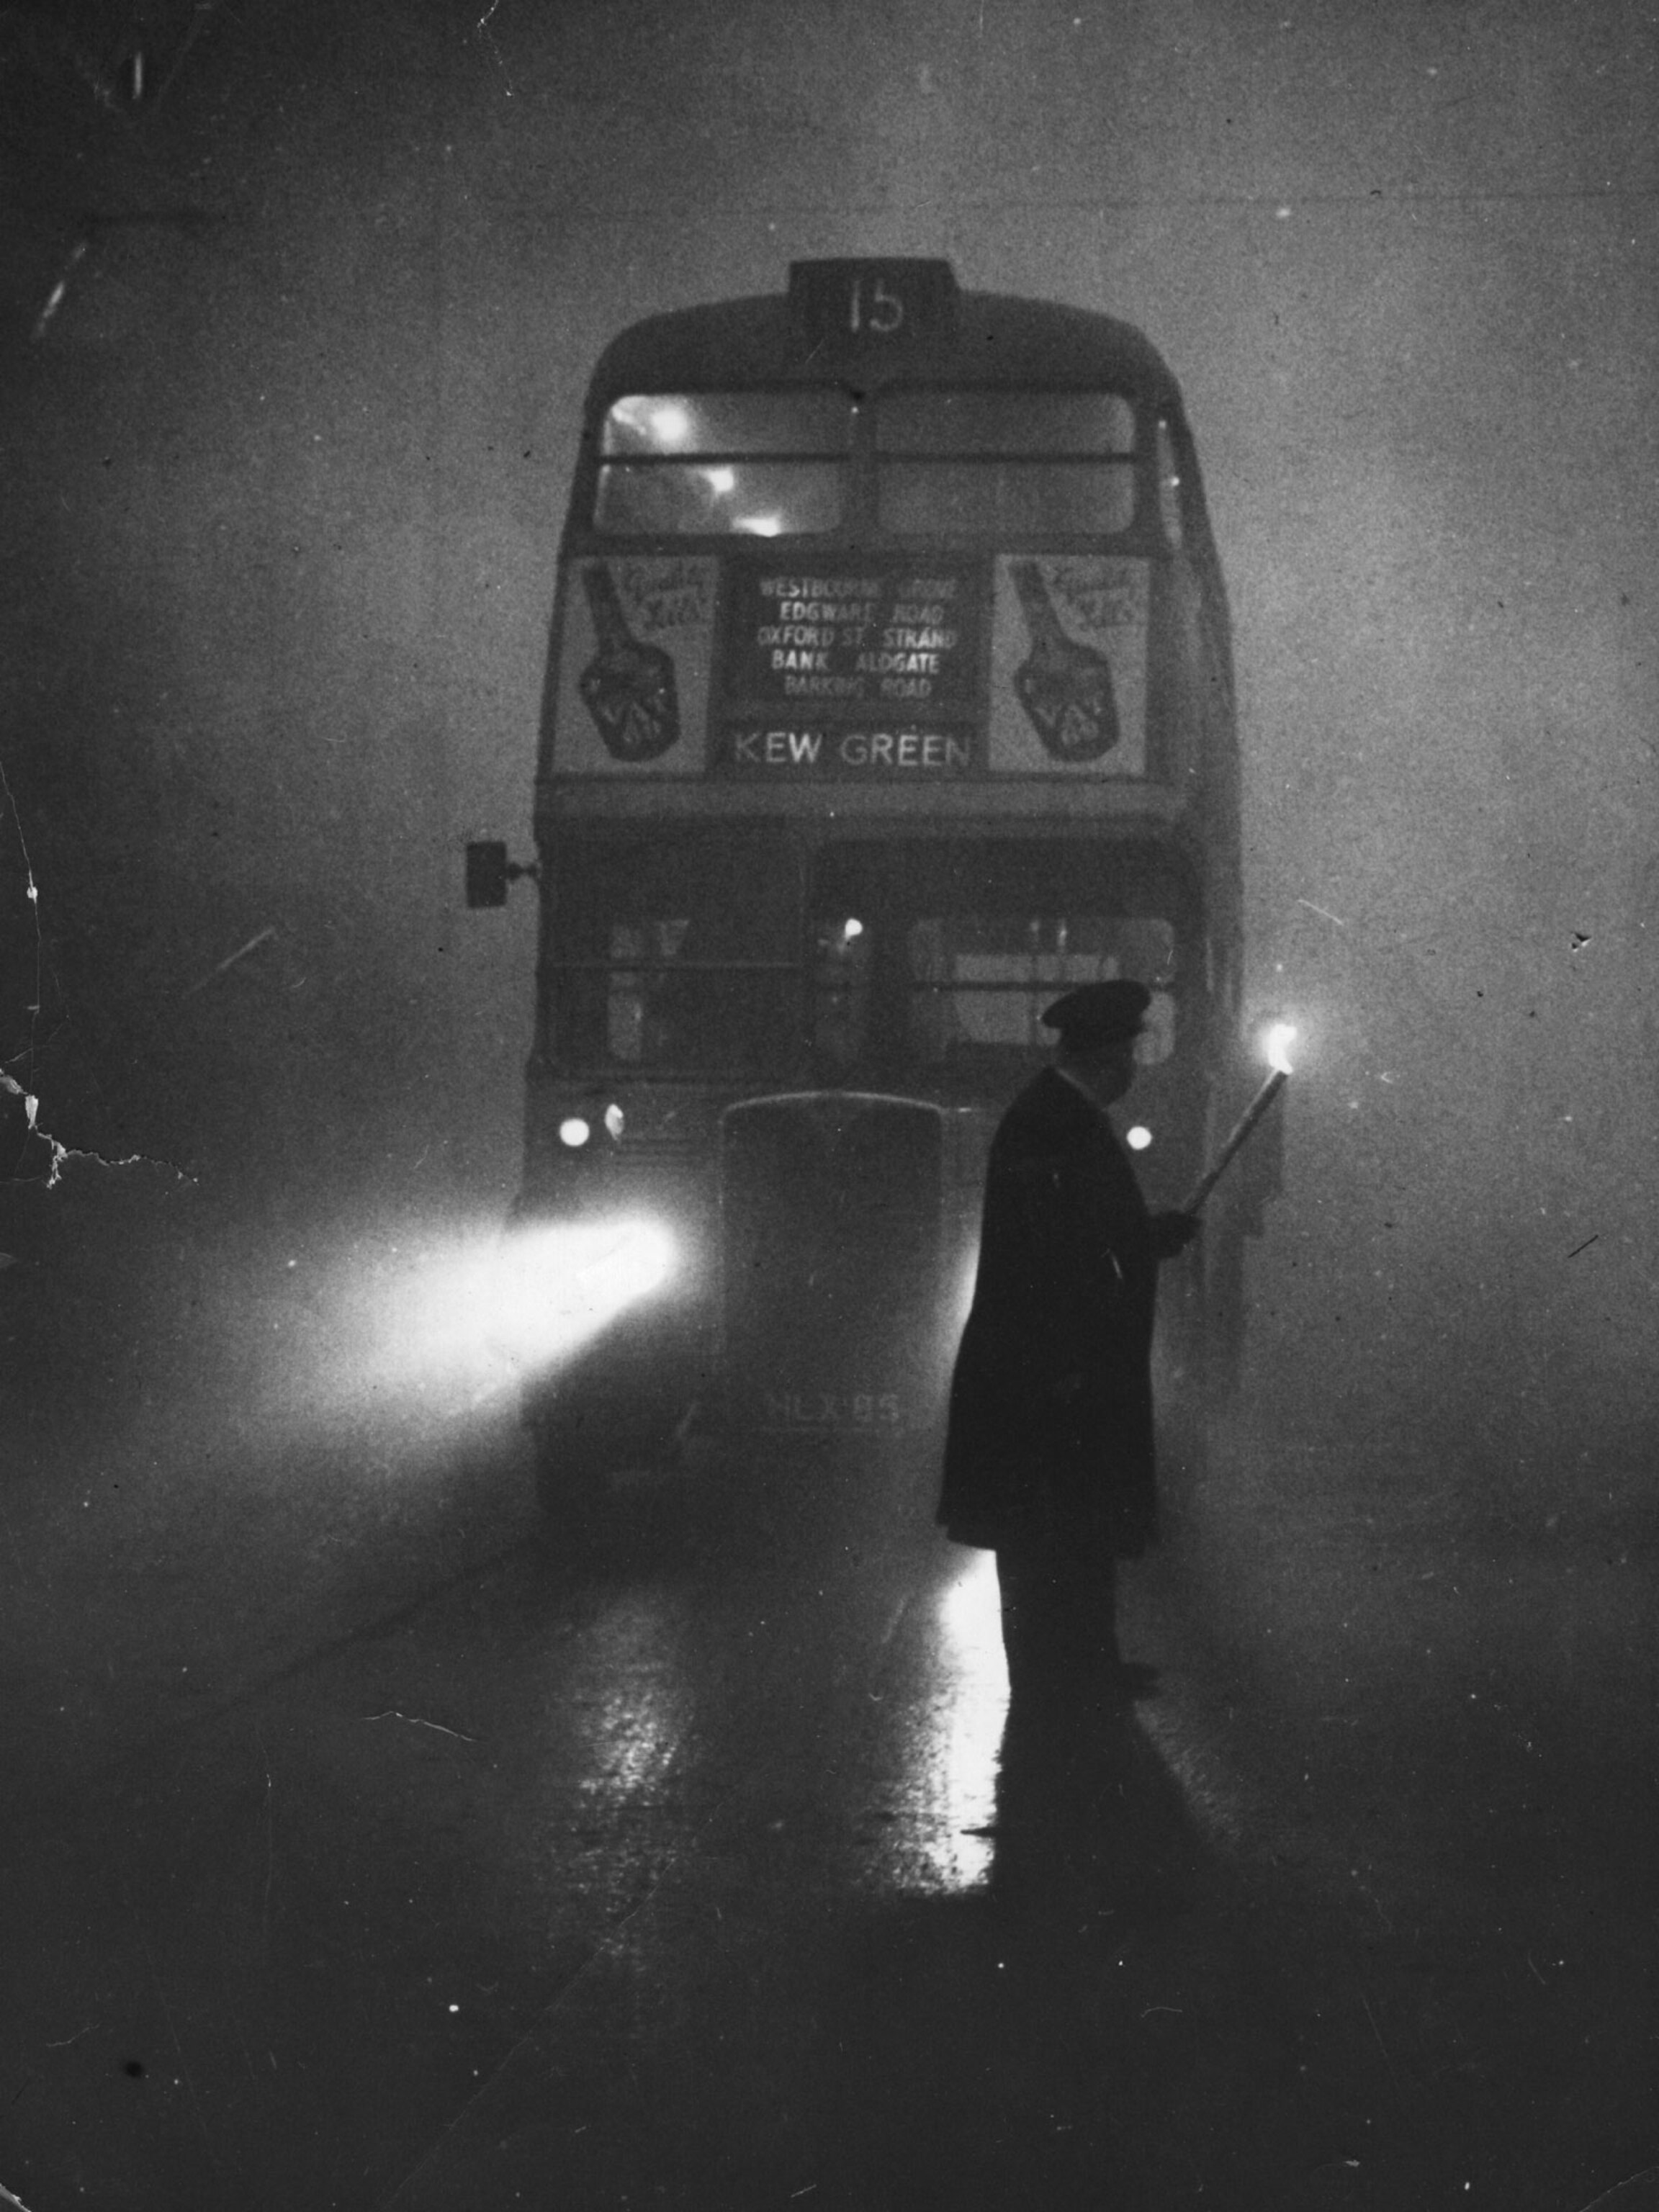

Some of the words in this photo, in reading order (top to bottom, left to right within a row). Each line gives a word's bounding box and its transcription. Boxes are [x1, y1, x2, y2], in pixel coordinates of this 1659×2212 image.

[850, 277, 904, 334] 15
[780, 601, 874, 622] EDGWARE
[757, 626, 835, 647] OXFORD
[883, 627, 958, 649] STRAND
[771, 649, 828, 670] BANK
[855, 652, 940, 673] ALDGATE
[733, 732, 822, 763] KEW
[840, 732, 971, 767] GREEN
